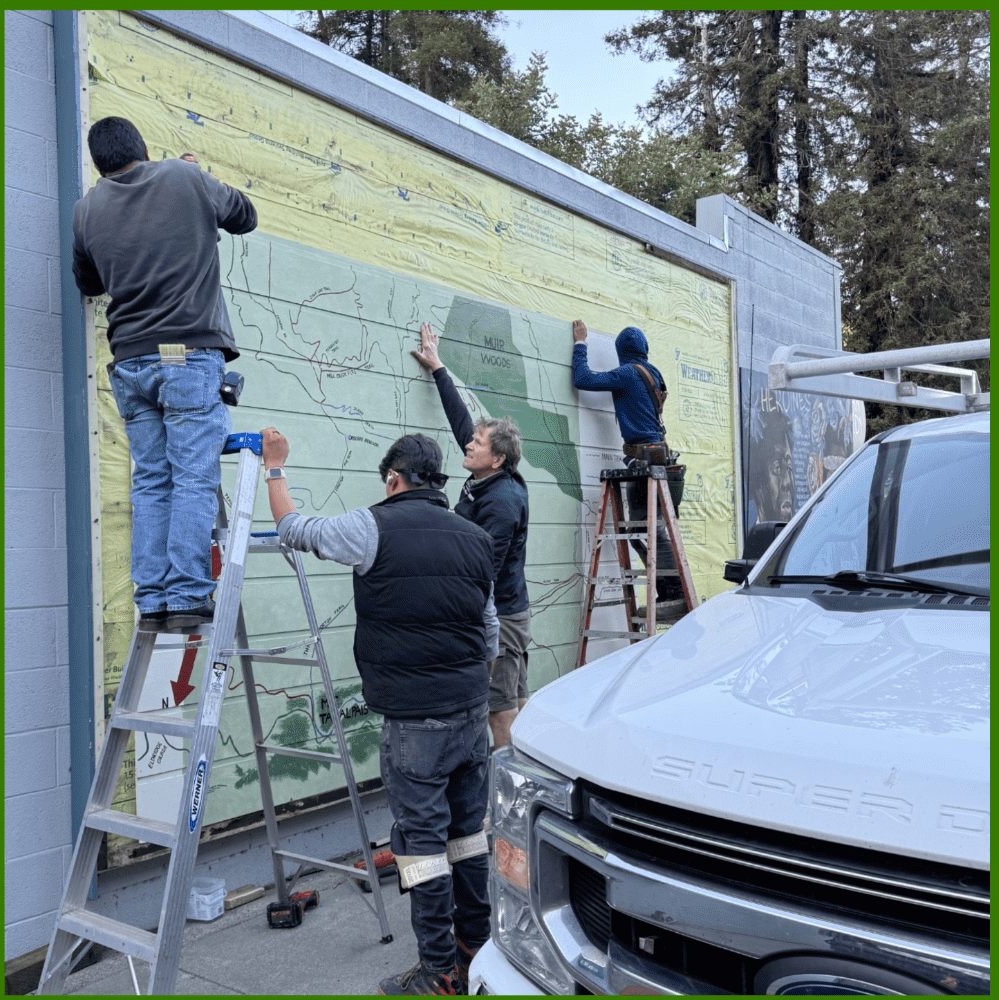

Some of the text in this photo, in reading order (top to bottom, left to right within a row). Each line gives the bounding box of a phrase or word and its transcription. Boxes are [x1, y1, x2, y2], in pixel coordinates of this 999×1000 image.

[484, 336, 504, 350] MUIR
[481, 353, 510, 368] WOODS
[162, 698, 169, 709] N
[319, 704, 368, 724] TAALPAIS
[148, 741, 163, 769] ELDRIDGE
[157, 745, 168, 764] GRADE
[191, 770, 203, 815] WERNER
[651, 753, 915, 824] SUPER
